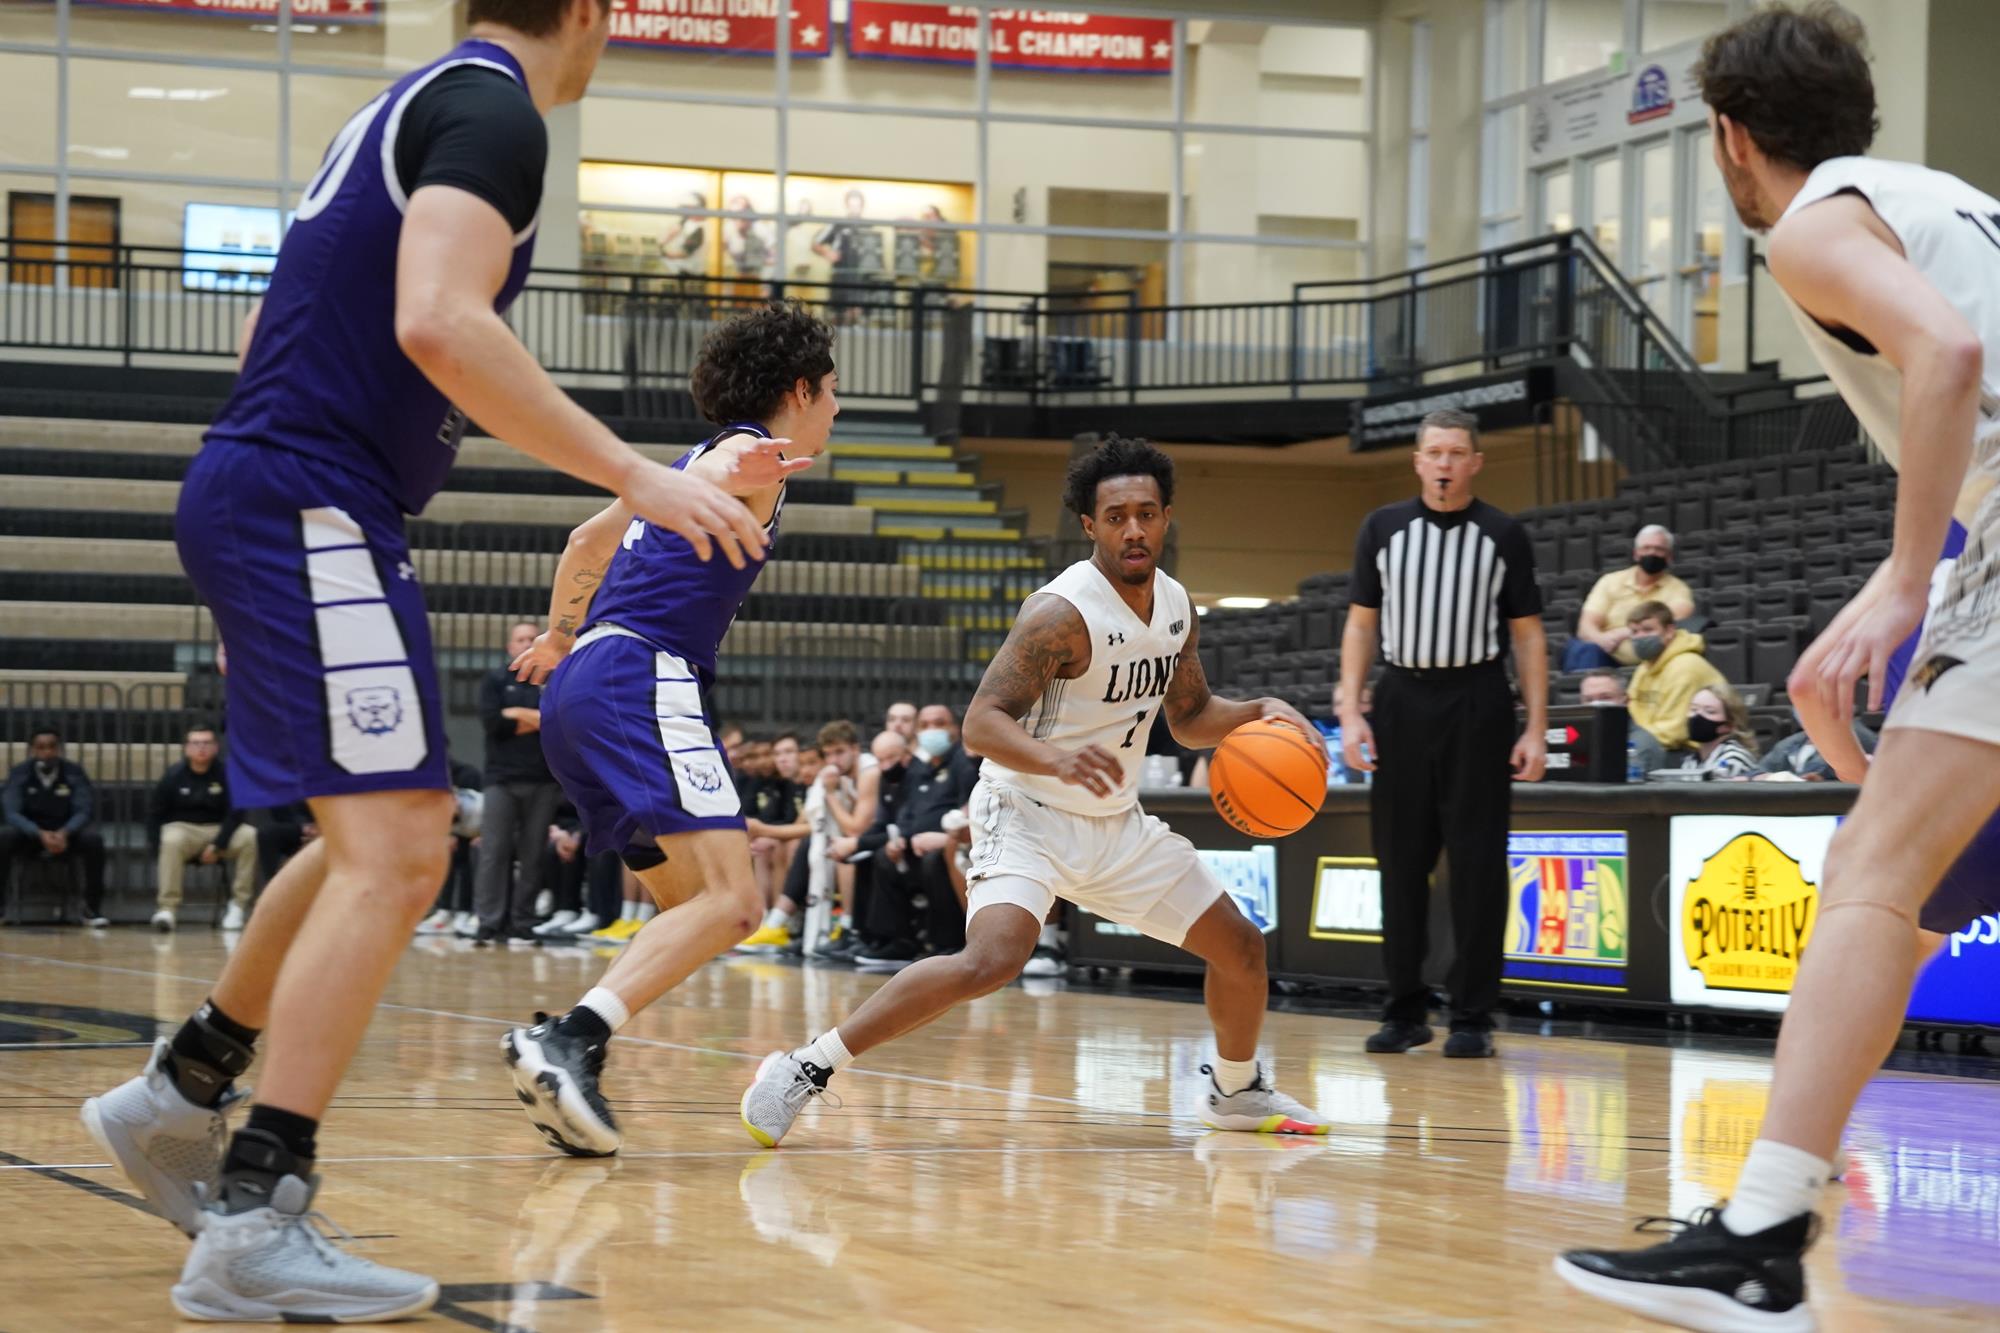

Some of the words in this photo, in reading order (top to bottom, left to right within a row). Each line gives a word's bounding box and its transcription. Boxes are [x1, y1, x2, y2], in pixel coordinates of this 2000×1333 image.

[1018, 30, 1145, 60] CHAMPION
[1120, 710, 1150, 749] 1
[1692, 896, 1813, 963] POTBELLY
